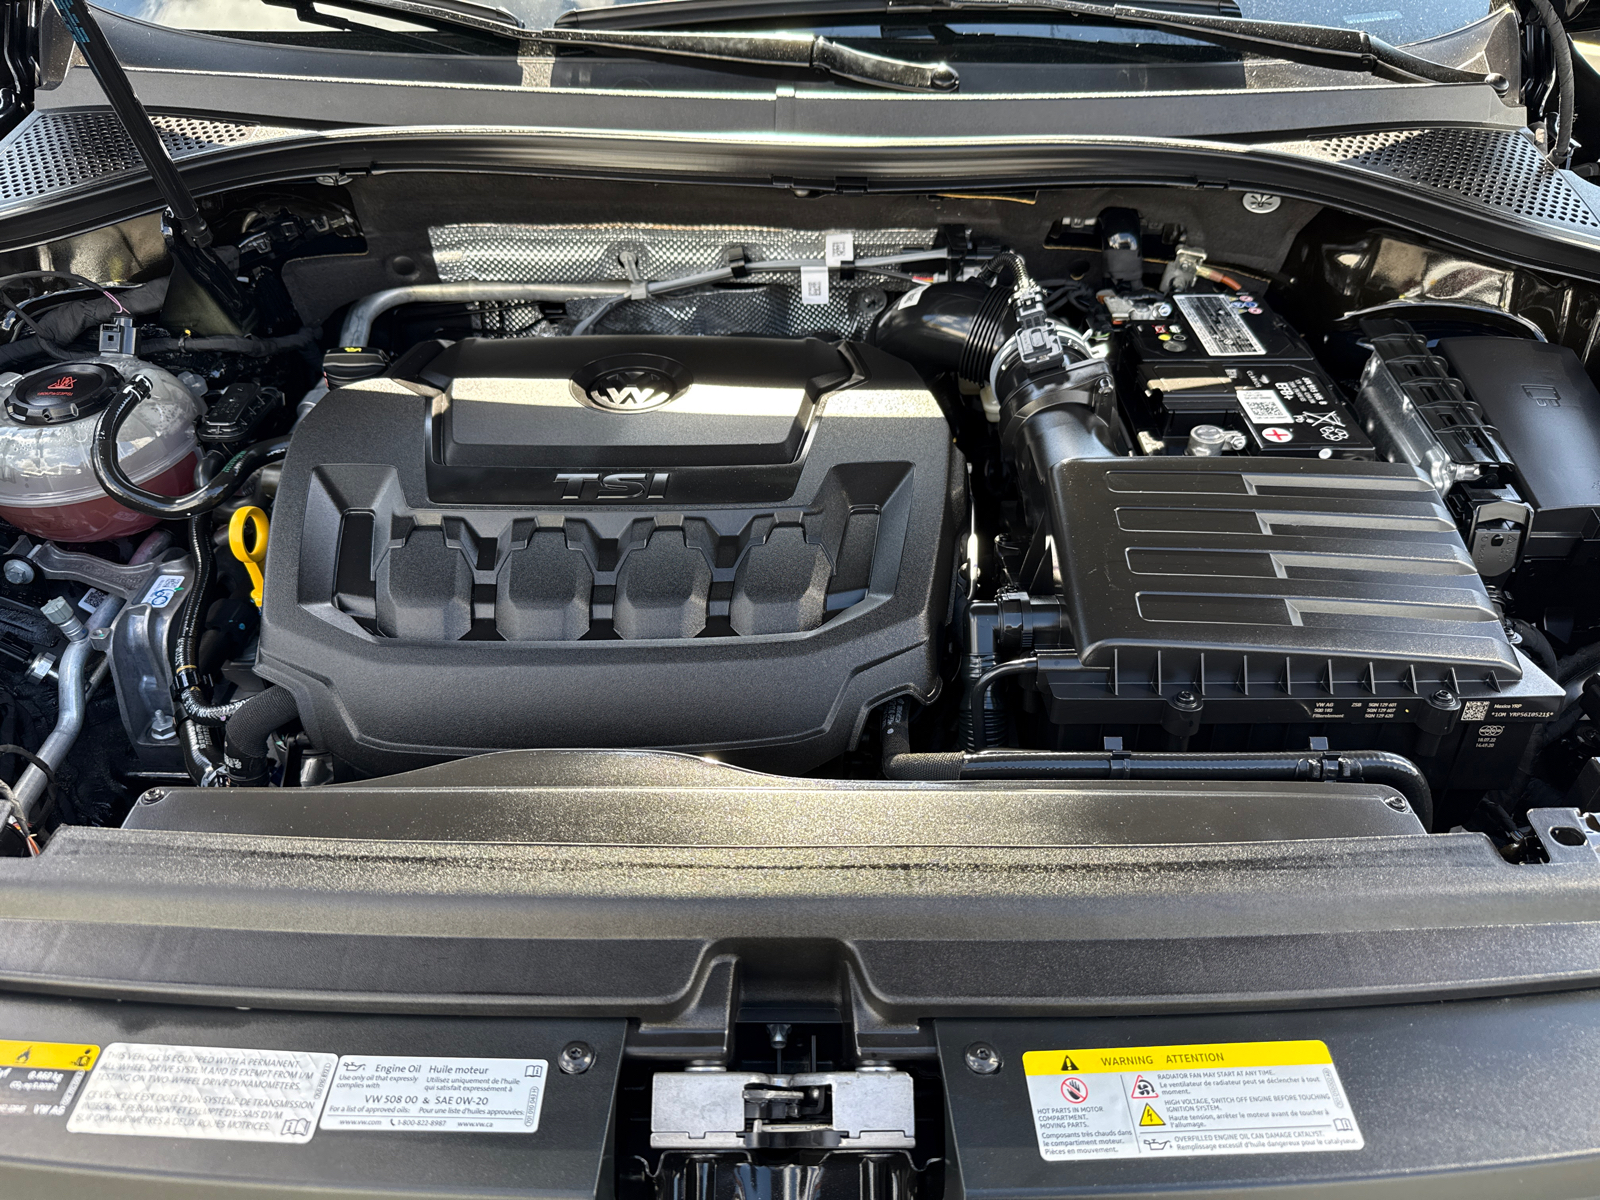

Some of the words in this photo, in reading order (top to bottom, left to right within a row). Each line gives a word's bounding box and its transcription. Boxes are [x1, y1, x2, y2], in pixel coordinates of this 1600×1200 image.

[1275, 382, 1294, 400] EFB+
[553, 473, 670, 499] TSI
[162, 1053, 171, 1061] IS
[216, 1056, 239, 1065] WITH
[240, 1057, 247, 1065] A
[247, 1058, 300, 1068] PERMANENT
[1100, 1056, 1153, 1066] WARNING
[1166, 1052, 1225, 1064] ATTENTION
[100, 1062, 146, 1072] ALL-WHEEL
[150, 1063, 174, 1072] DRIVE
[208, 1067, 228, 1075] AND
[230, 1067, 238, 1076] IS
[239, 1068, 273, 1078] EXEMPT
[273, 1070, 298, 1079] FROM
[375, 1064, 406, 1075] Engine
[408, 1064, 422, 1073] Oil
[428, 1065, 453, 1074] Huile
[455, 1067, 489, 1075] moteur
[351, 1074, 366, 1083] only
[389, 1075, 419, 1083] expressly
[1157, 1072, 1188, 1080] RADIATOR
[132, 1074, 146, 1082] ON
[149, 1074, 200, 1086] TWO-WHEEL
[202, 1077, 228, 1087] DRIVE
[229, 1079, 301, 1090] DYNAMOMETERS.
[336, 1081, 364, 1090] complies
[451, 1077, 490, 1085] uniquement
[1168, 1080, 1203, 1088] ventilateur
[462, 1085, 507, 1093] expressément
[365, 1094, 383, 1103] VW
[384, 1095, 403, 1104] 508
[404, 1095, 418, 1104] 00
[435, 1096, 454, 1105] SAE
[455, 1096, 489, 1106] 0W-20
[1273, 1094, 1297, 1102] BEFORE
[1298, 1093, 1331, 1101] TOUCHING
[240, 1097, 251, 1106] DE
[254, 1098, 316, 1110] TRANSMISSION
[1195, 1104, 1222, 1112] SYSTEM.
[365, 1106, 396, 1114] approved
[418, 1106, 434, 1114] Pour
[462, 1107, 486, 1115] d'huiles
[172, 1117, 196, 1127] DEUX
[397, 1119, 447, 1127] 1-800-822-8987
[1041, 1132, 1081, 1140] Composants
[1174, 1135, 1213, 1143] OVERFILLED
[1265, 1131, 1292, 1139] DAMAGE
[1293, 1130, 1326, 1138] CATALYST.
[1051, 1140, 1098, 1148] compartiment
[1176, 1143, 1218, 1151] Remplissage
[1244, 1140, 1266, 1148] d'huile
[1267, 1140, 1301, 1148] dangereux
[1301, 1139, 1316, 1147] pour
